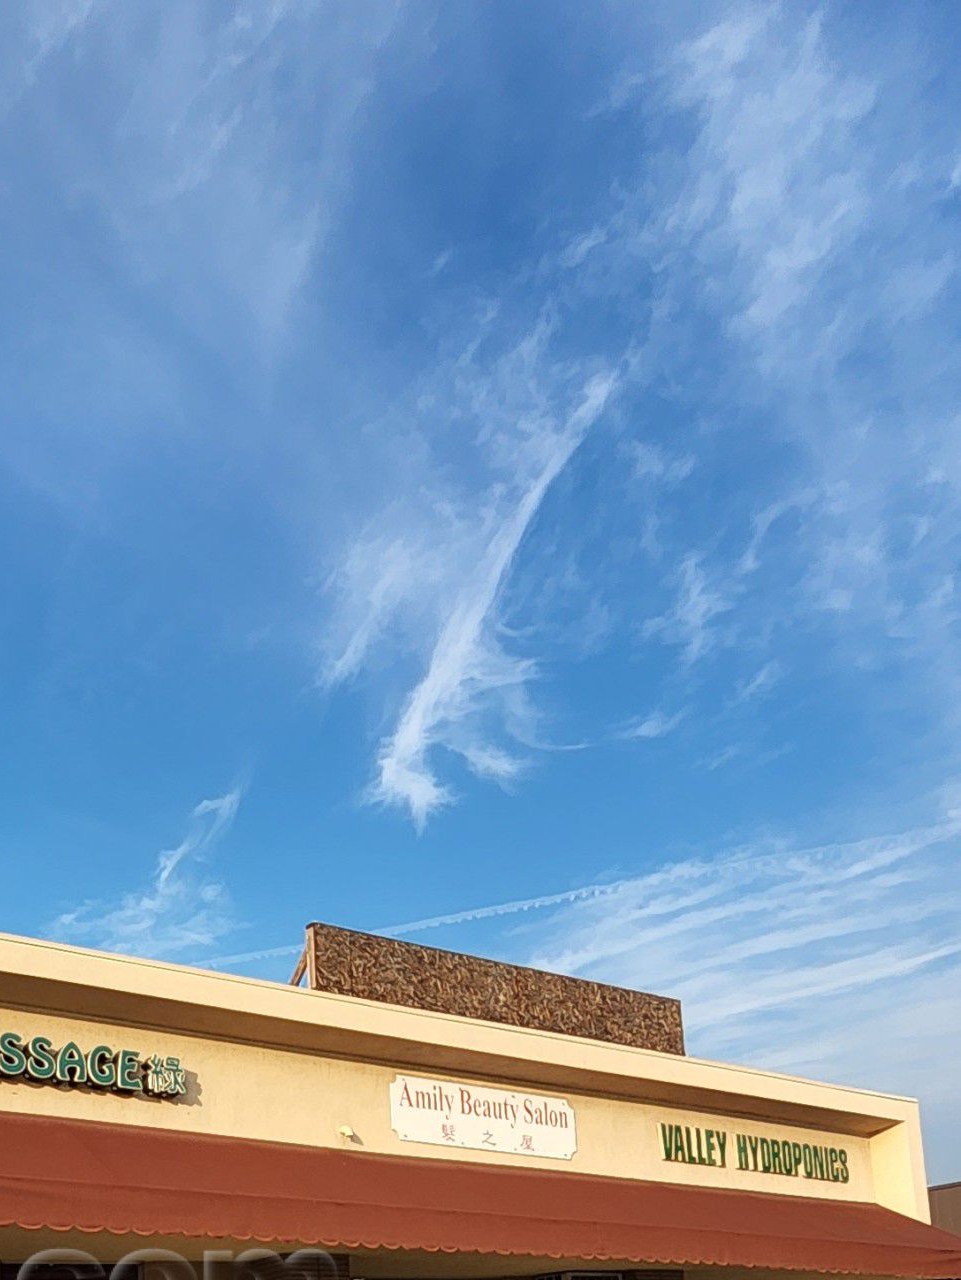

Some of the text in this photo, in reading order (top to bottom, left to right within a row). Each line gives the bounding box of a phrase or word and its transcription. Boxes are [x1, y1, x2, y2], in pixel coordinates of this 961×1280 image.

[399, 1081, 569, 1129] Amily Beauty Salon
[660, 1122, 850, 1184] VALLEY HYDROPONICS
